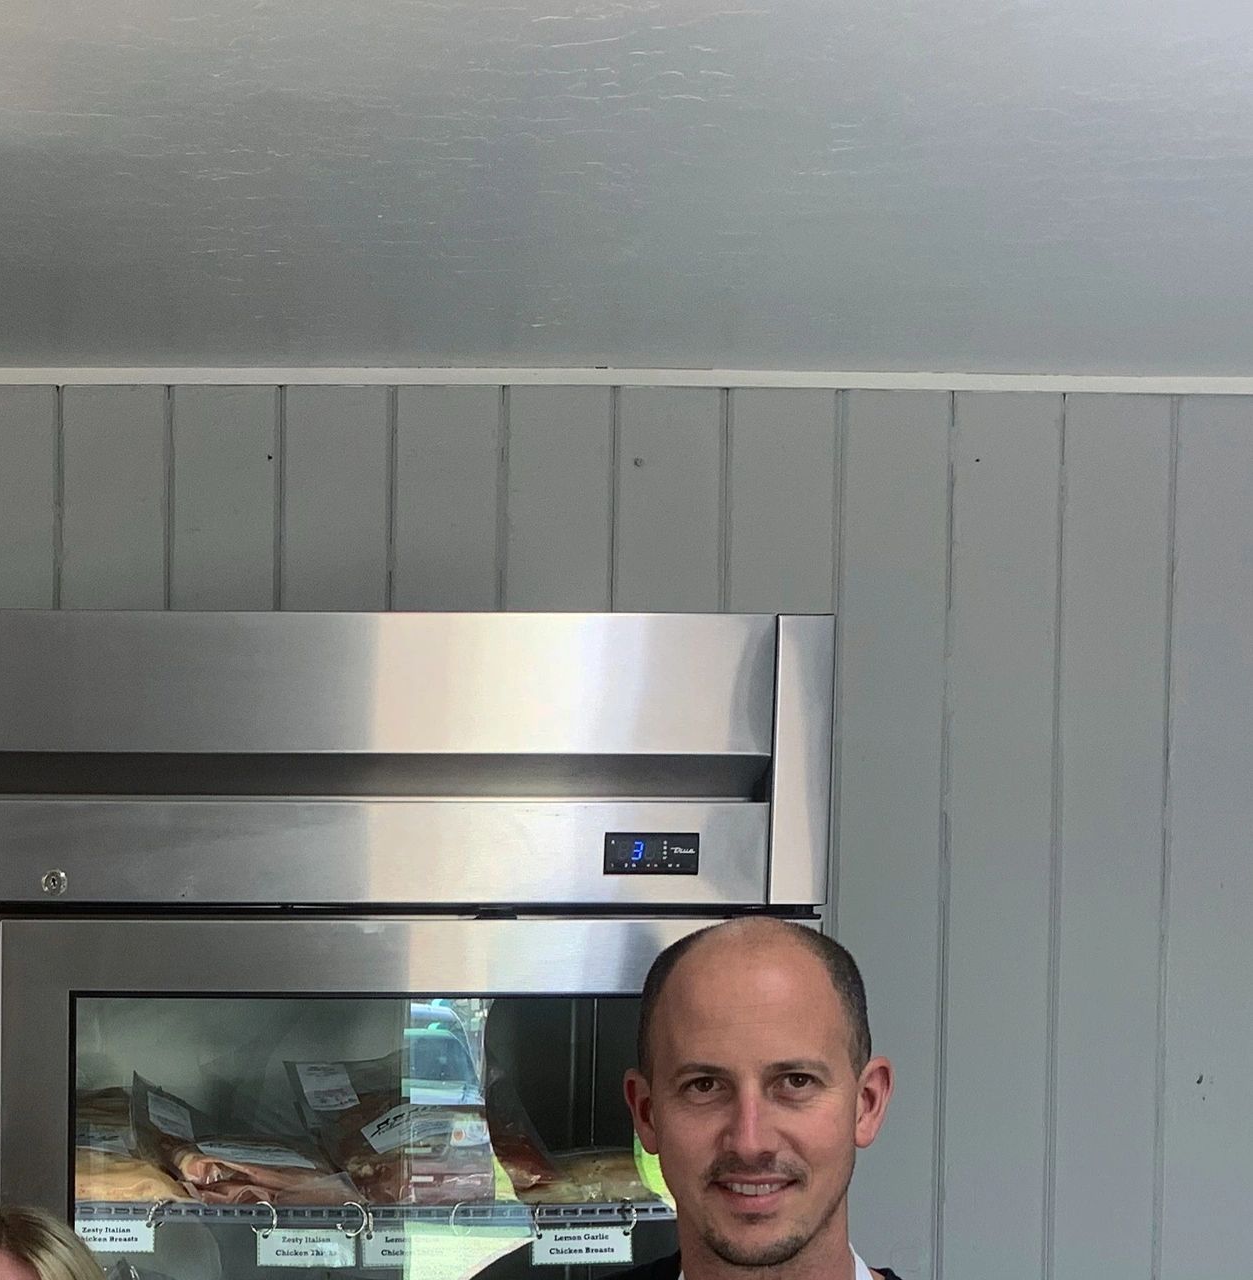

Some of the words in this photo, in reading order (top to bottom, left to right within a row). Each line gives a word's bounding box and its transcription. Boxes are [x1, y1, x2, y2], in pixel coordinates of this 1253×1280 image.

[631, 841, 644, 860] 3
[81, 1226, 103, 1235] Zesty
[109, 1235, 138, 1243] Breasts
[281, 1236, 303, 1244] Zesty
[275, 1249, 309, 1257] Chicken
[549, 1247, 583, 1255] Chicken
[584, 1246, 615, 1254] Breasts
